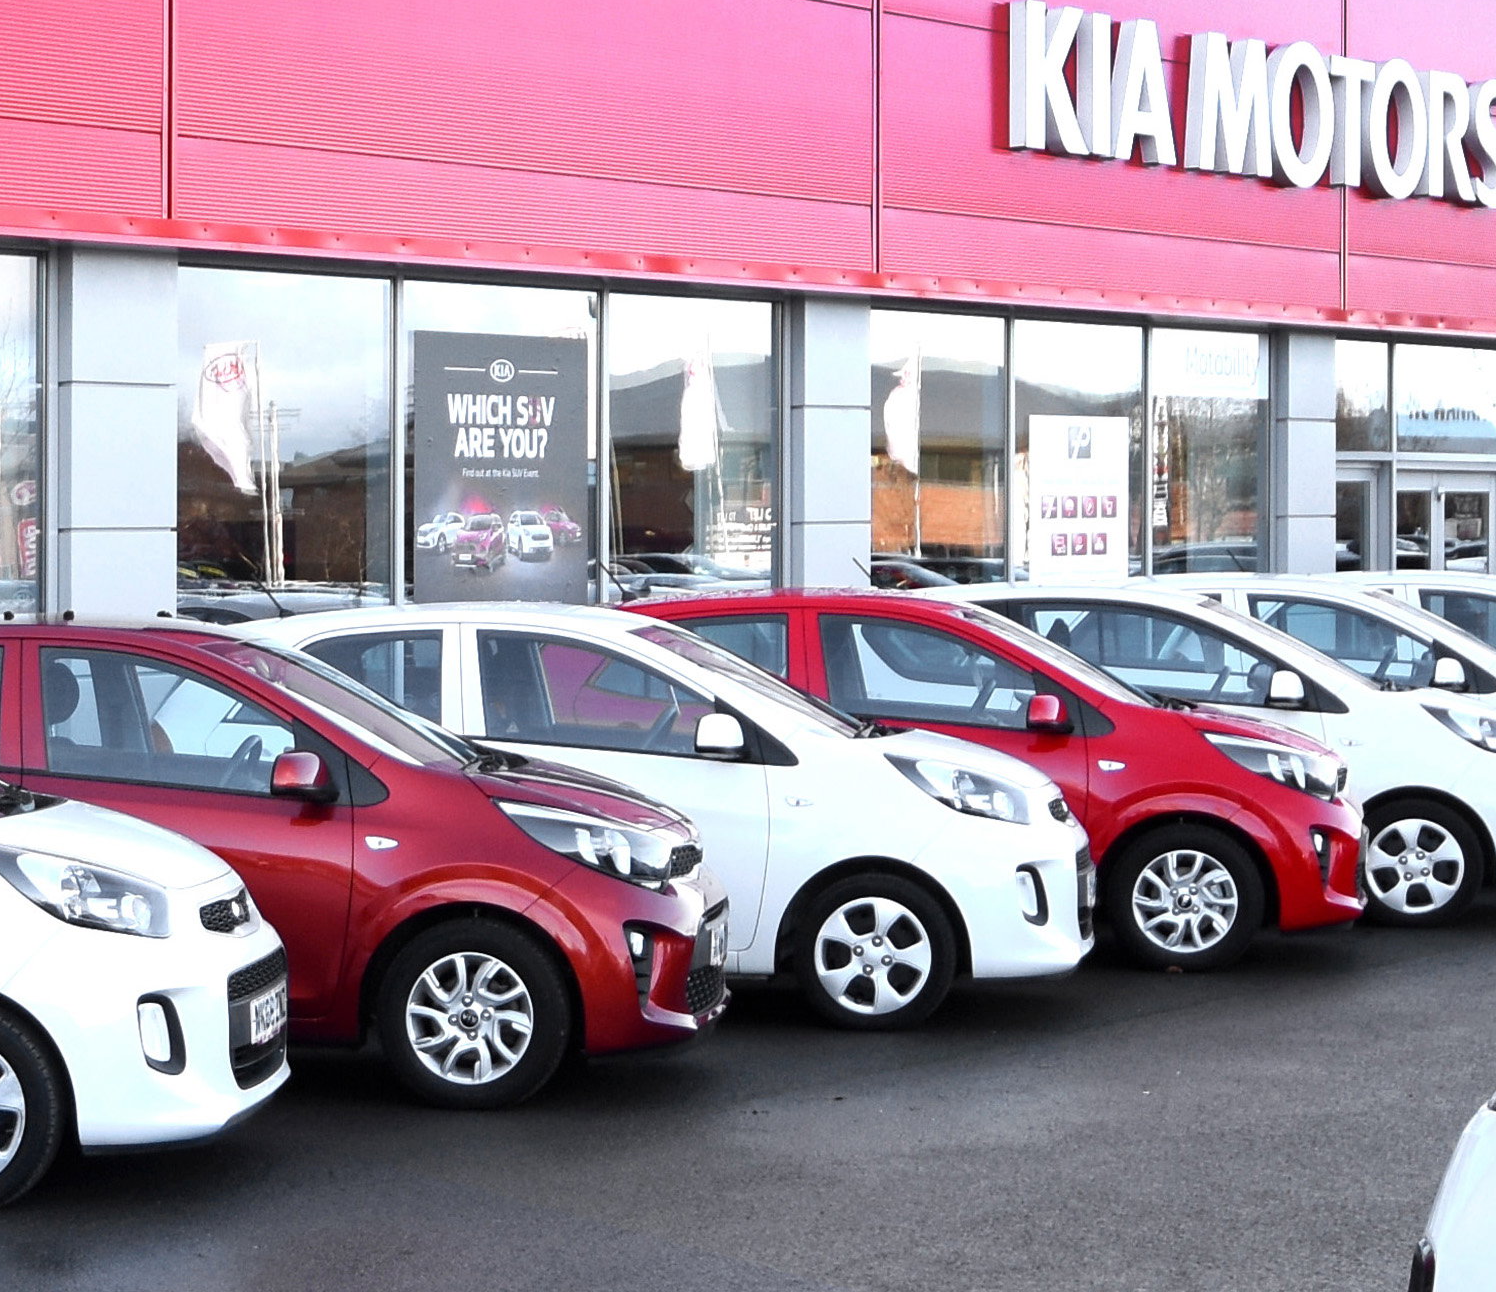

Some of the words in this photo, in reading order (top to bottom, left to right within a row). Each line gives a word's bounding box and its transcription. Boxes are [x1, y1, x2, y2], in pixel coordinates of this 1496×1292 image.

[1010, 0, 1177, 165] KIA
[447, 394, 512, 425] WHICH
[516, 395, 556, 427] SUV
[454, 427, 496, 458] ARE
[499, 428, 549, 459] YOU?
